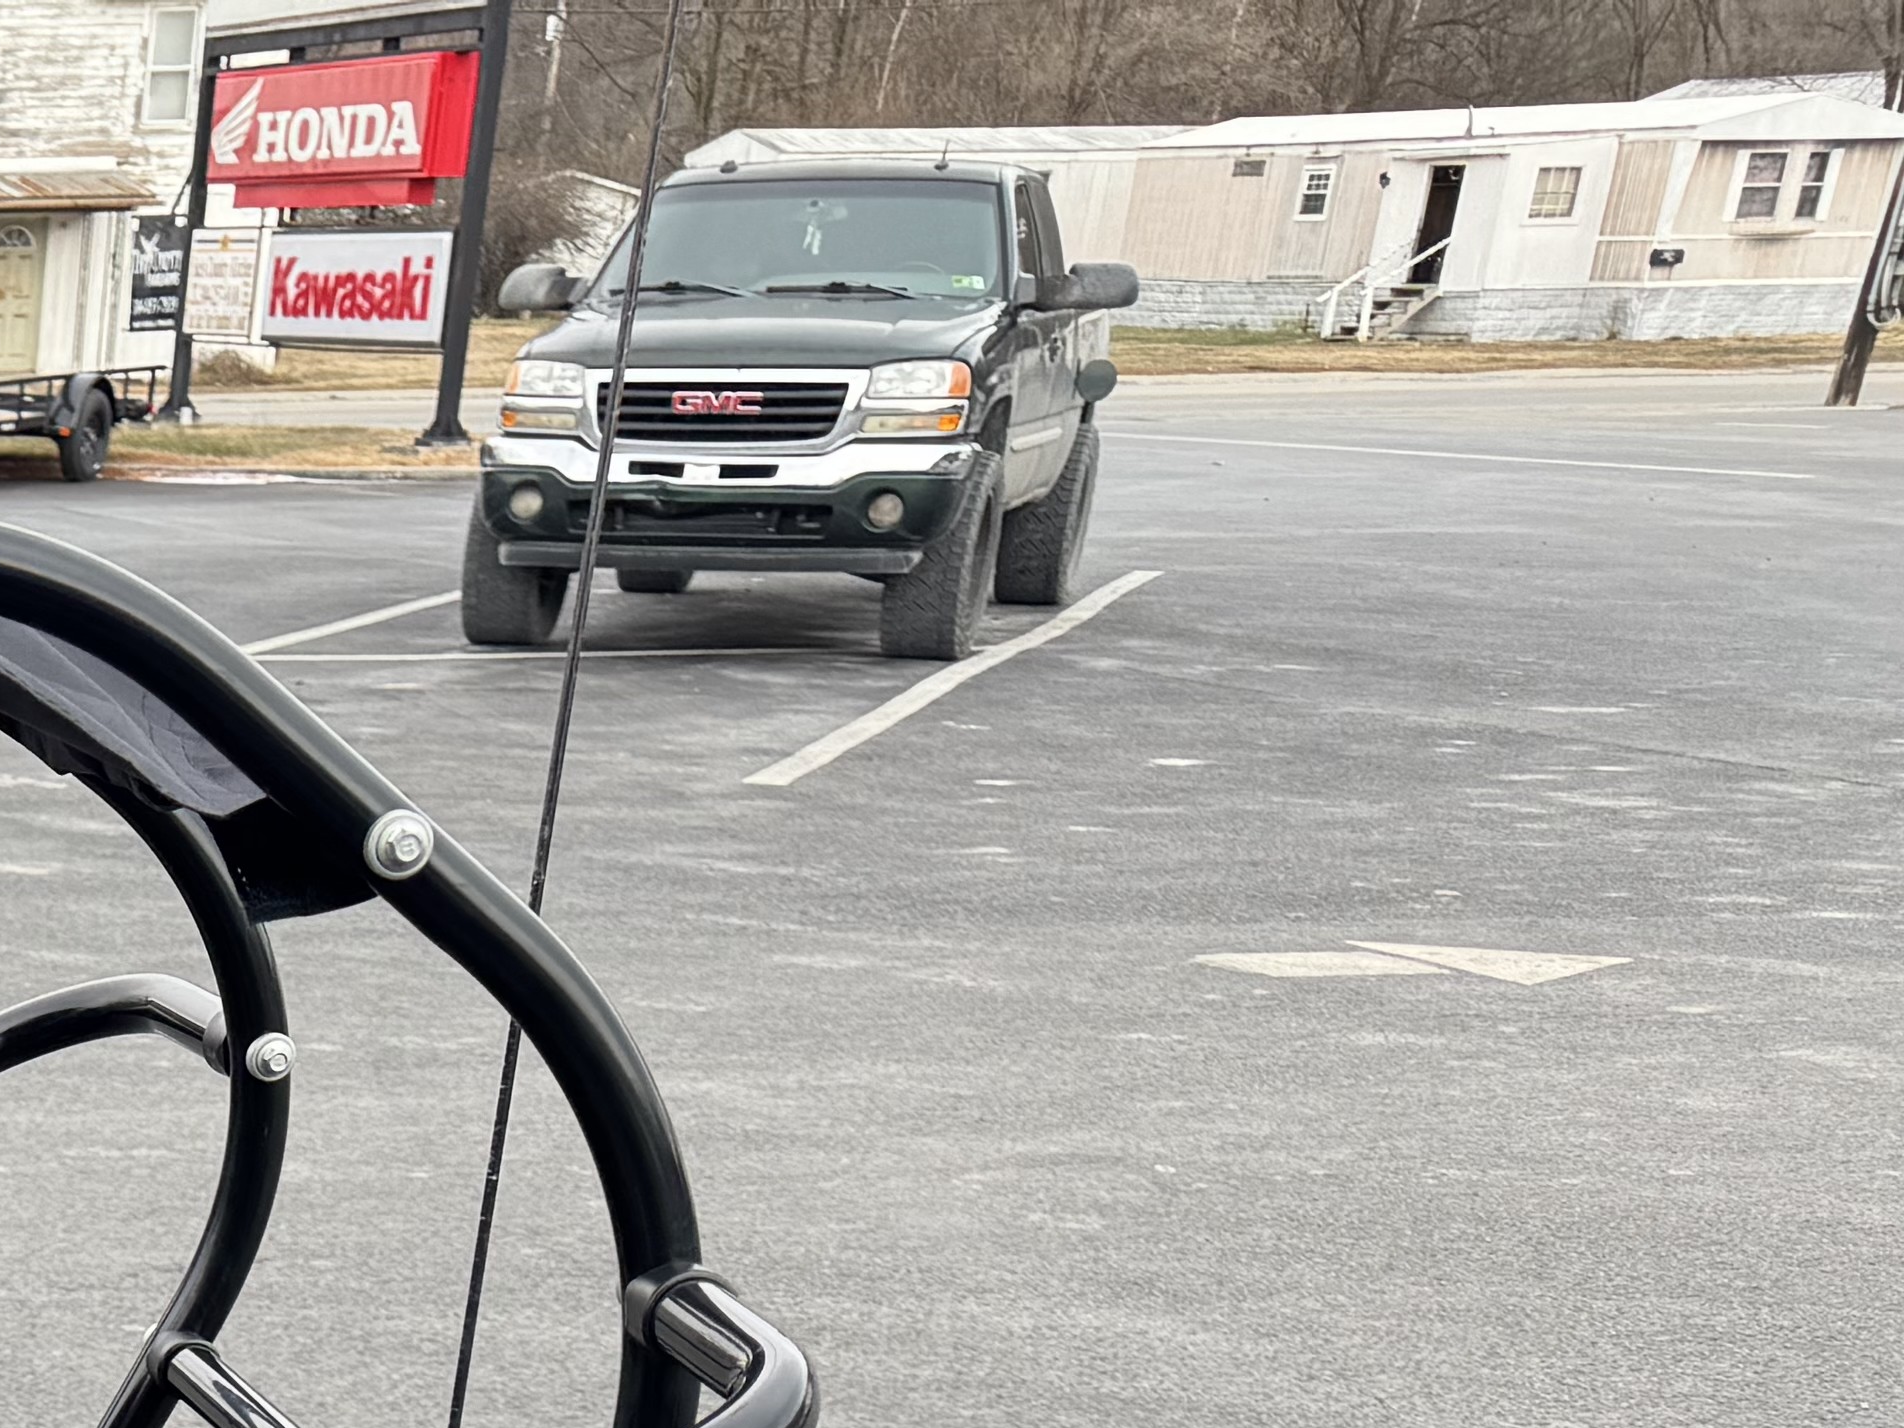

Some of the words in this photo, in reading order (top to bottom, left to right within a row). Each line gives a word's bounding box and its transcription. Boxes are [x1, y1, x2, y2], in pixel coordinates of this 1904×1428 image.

[252, 101, 422, 162] HONDA
[268, 255, 435, 321] Kawasaki
[672, 391, 765, 416] GMC
